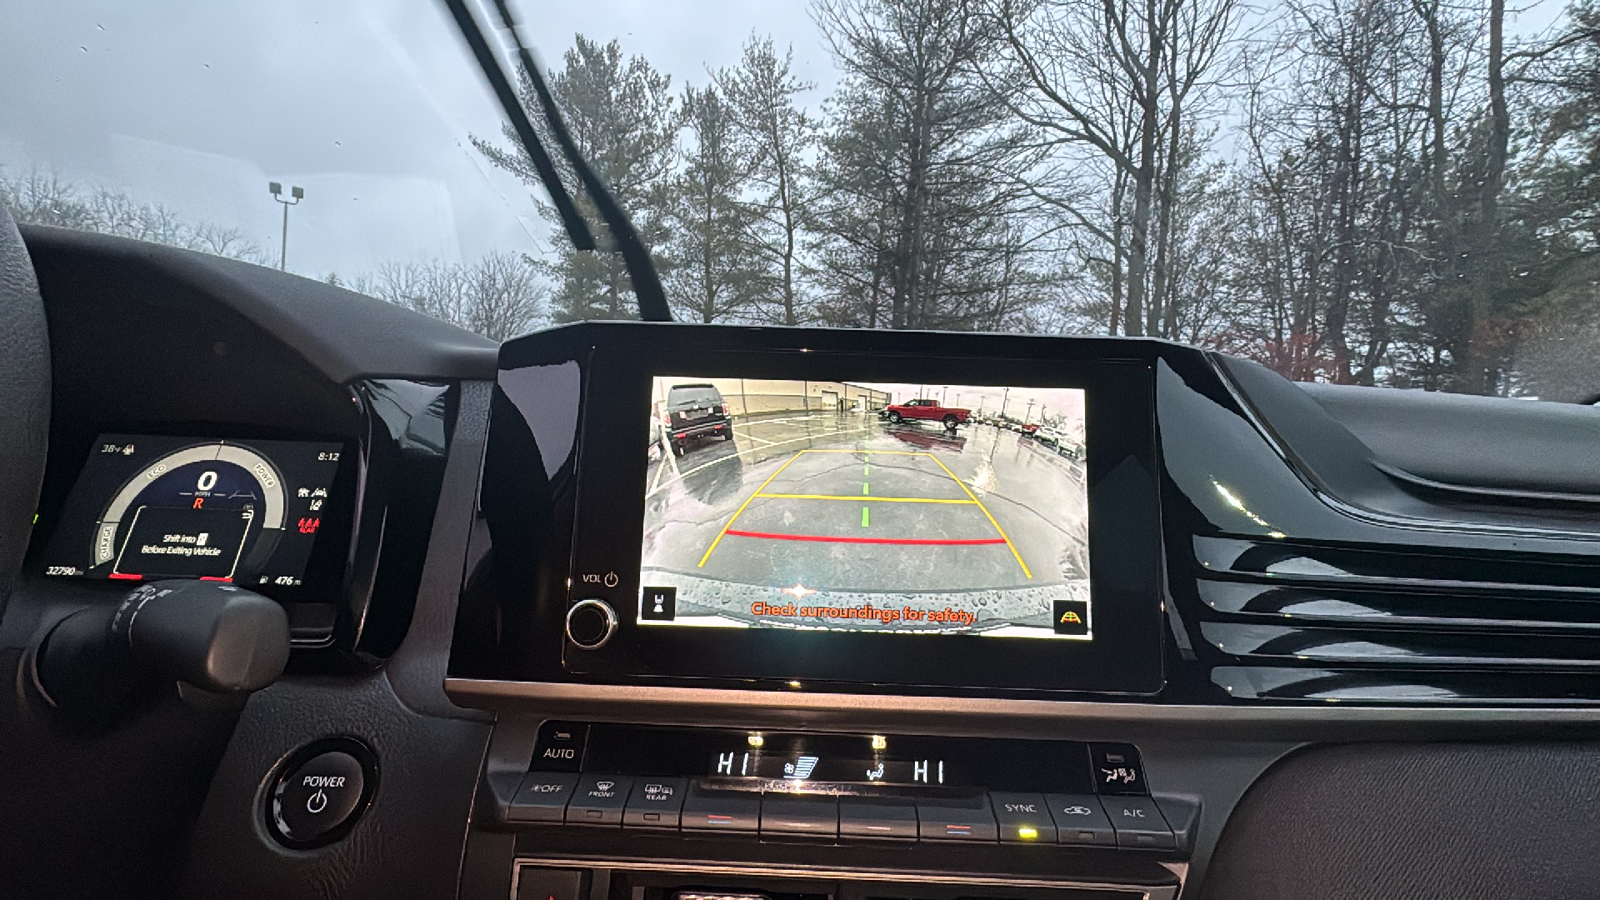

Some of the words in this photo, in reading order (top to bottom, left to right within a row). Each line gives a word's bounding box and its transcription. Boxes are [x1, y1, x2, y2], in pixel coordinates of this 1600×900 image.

[318, 452, 340, 461] 8:12
[146, 464, 166, 479] ECO
[254, 462, 275, 489] POWER
[197, 471, 218, 491] 0
[192, 497, 205, 510] R
[163, 534, 181, 543] Shift
[180, 534, 197, 544] into
[141, 545, 167, 554] Before
[166, 546, 193, 557] Exiting
[193, 547, 222, 556] Vehicle
[46, 566, 76, 576] 32790
[274, 576, 294, 586] 476
[582, 573, 602, 583] VOL
[751, 601, 798, 617] Check
[799, 604, 901, 623] surroundings
[902, 606, 926, 622] for
[927, 607, 978, 626] safety.
[543, 748, 575, 759] AUTO
[302, 775, 346, 788] POWER
[540, 784, 563, 793] OFF
[588, 790, 615, 798] FRONT
[1005, 803, 1037, 813] SYNC
[1123, 808, 1145, 818] A/C
